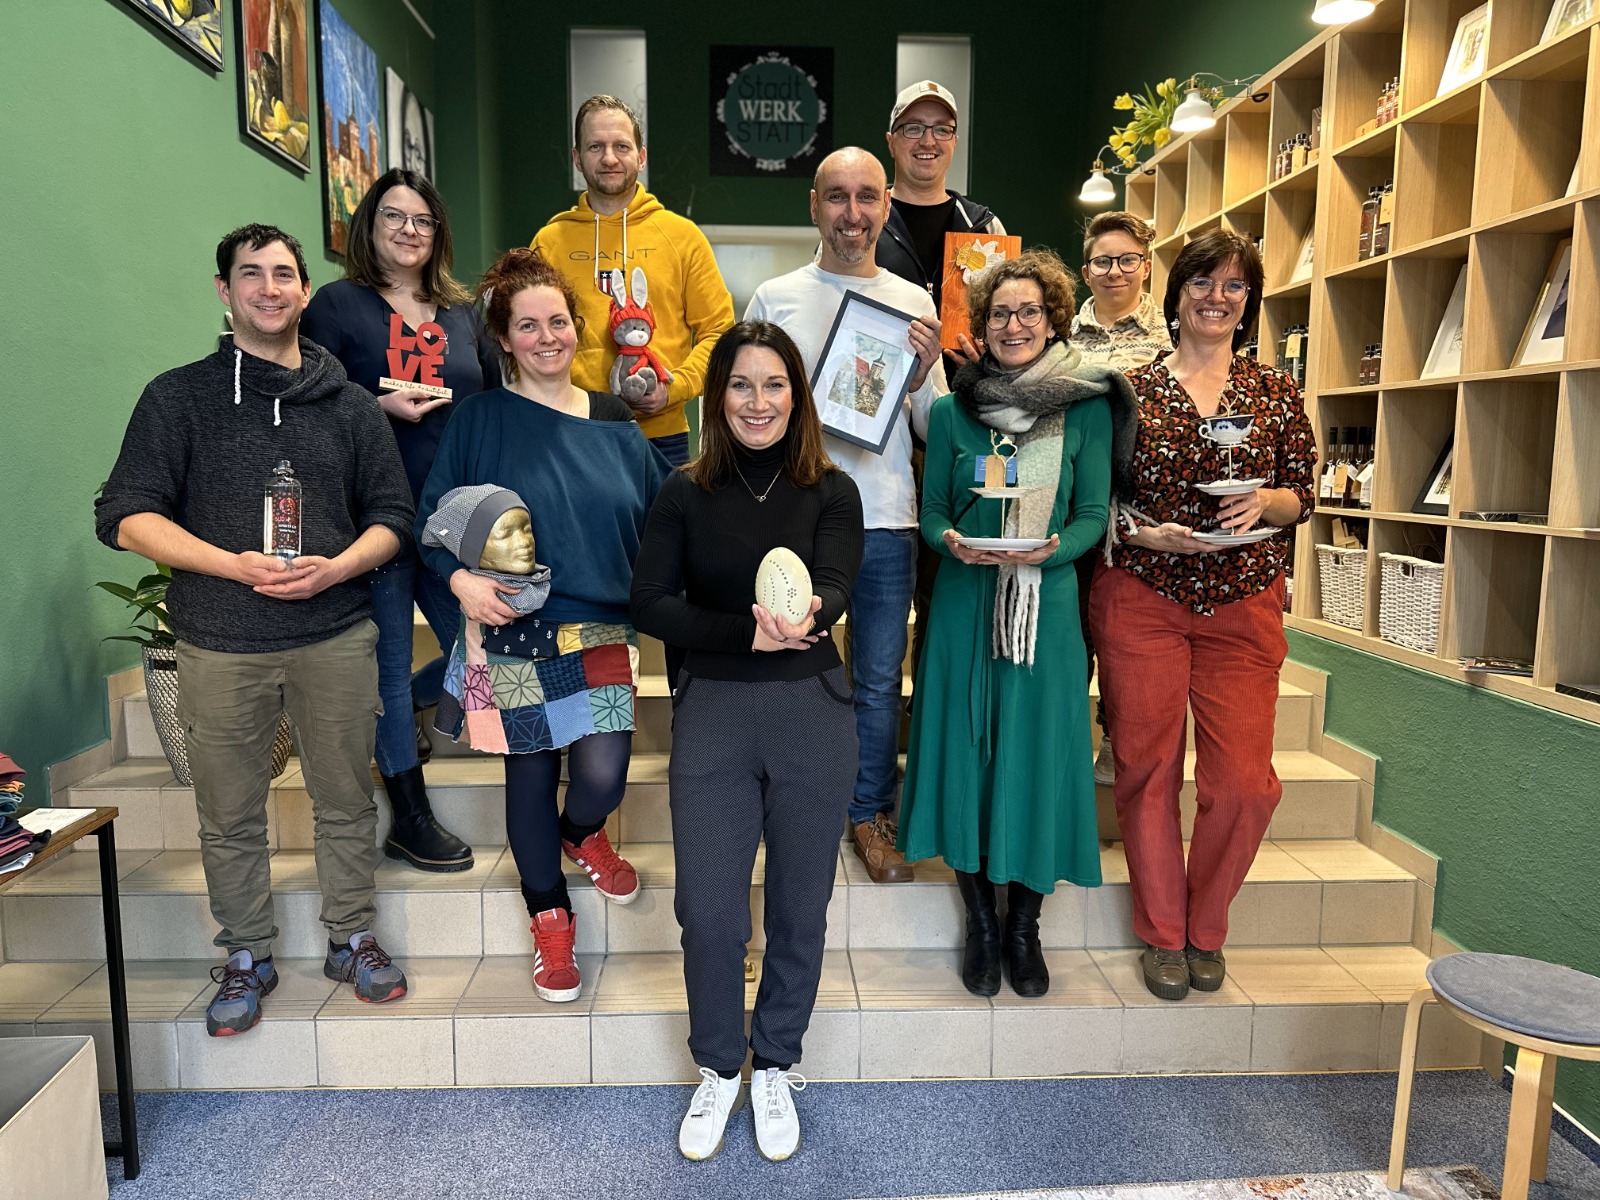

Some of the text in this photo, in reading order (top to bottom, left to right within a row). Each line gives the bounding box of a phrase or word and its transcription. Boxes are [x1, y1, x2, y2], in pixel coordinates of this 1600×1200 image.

[738, 75, 803, 99] Stadt
[739, 100, 803, 122] WERK
[737, 121, 809, 143] STATT
[569, 248, 657, 261] GANT
